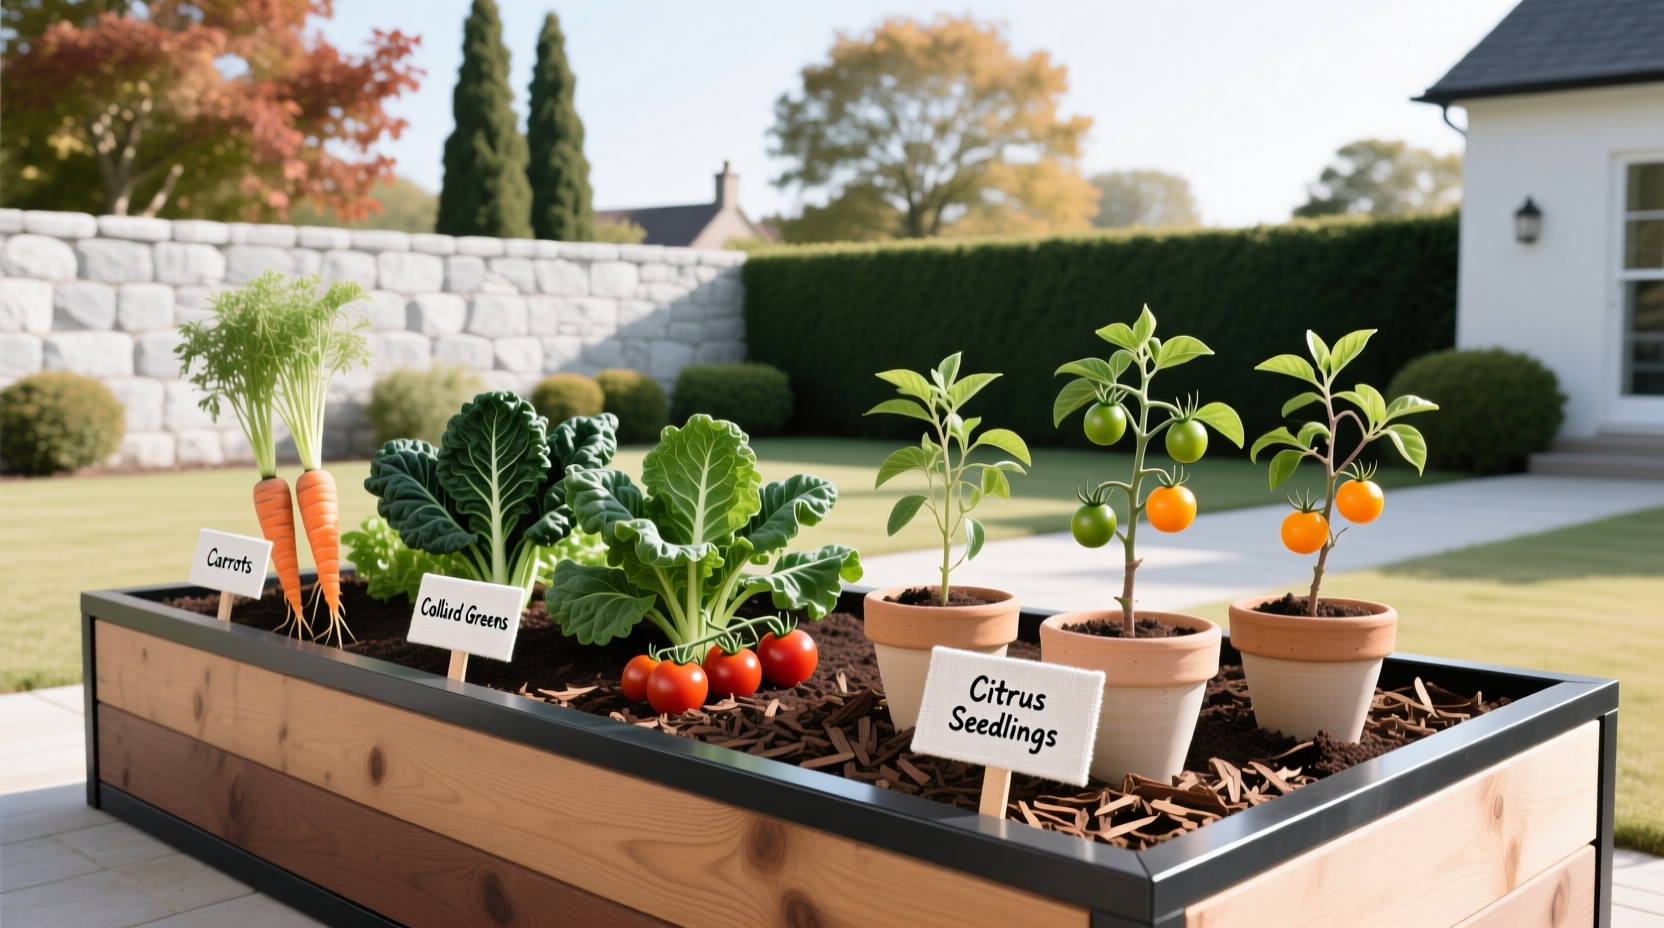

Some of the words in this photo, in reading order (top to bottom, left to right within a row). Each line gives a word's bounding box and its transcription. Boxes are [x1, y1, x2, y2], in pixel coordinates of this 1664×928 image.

[207, 547, 253, 575] Carrots
[465, 604, 509, 631] Greens
[969, 674, 1047, 712] Citrus
[948, 705, 1058, 755] Seedlings
